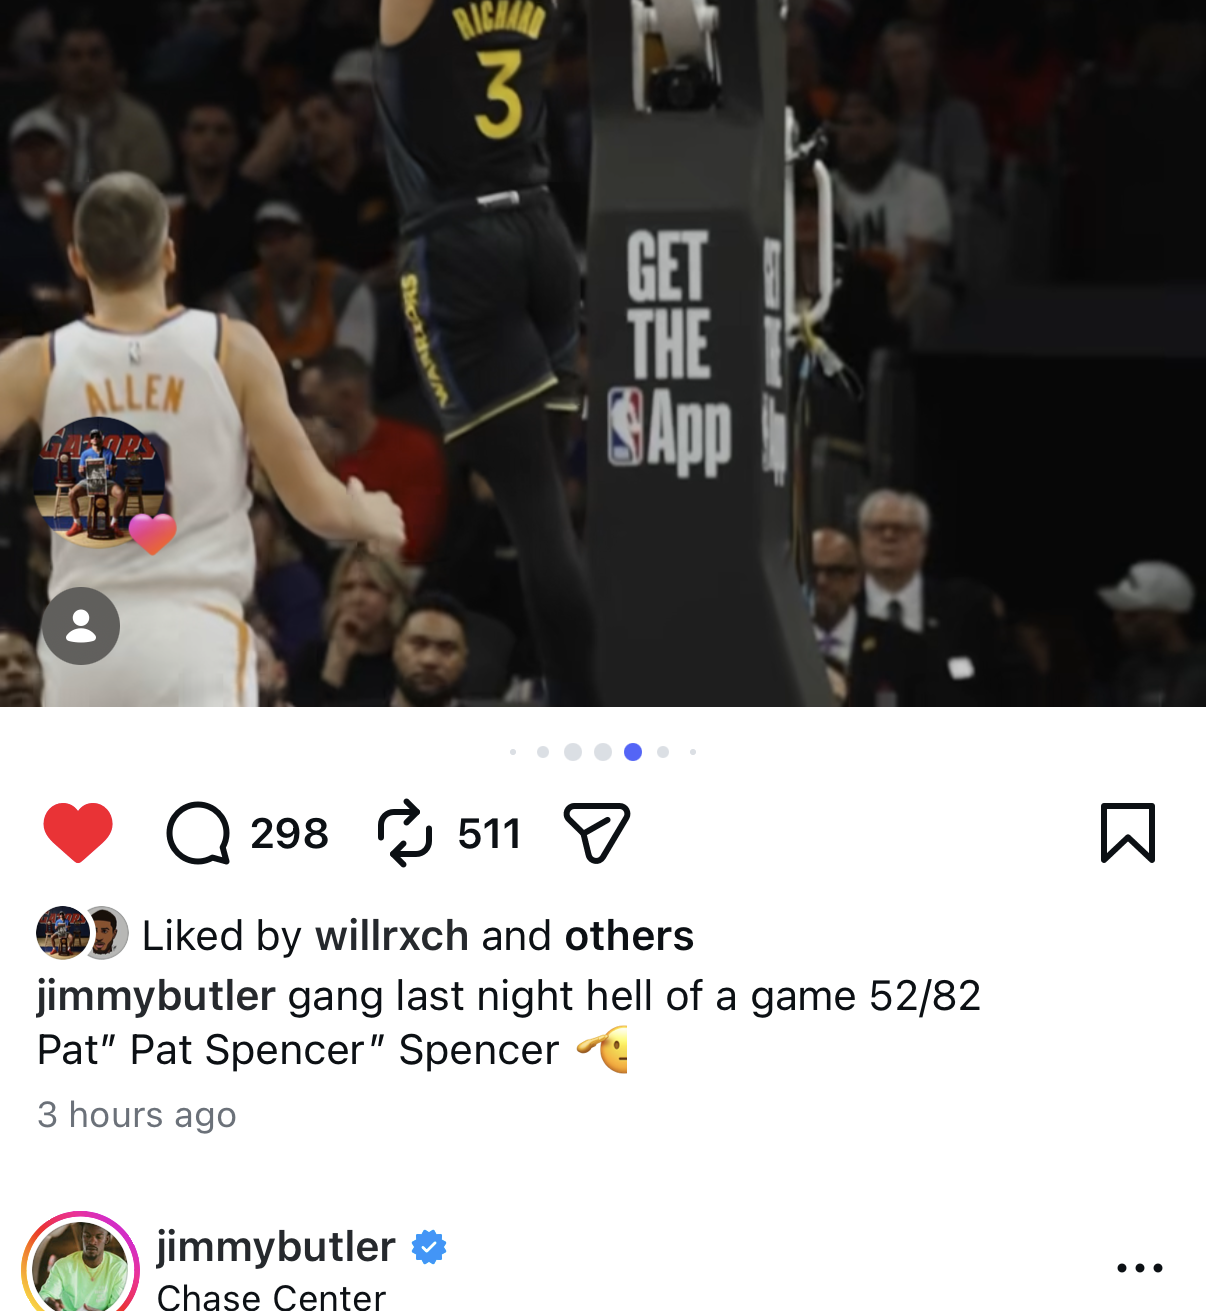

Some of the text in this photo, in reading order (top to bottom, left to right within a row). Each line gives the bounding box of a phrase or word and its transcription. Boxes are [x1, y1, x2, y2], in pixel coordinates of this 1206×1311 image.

[475, 49, 522, 139] 3
[627, 230, 709, 302] GET
[627, 307, 711, 379] THE
[84, 373, 185, 417] ALLEN
[647, 388, 732, 479] App
[252, 816, 328, 850] 298
[459, 817, 519, 850] 511
[145, 918, 694, 959] Liked by willrxch and others
[36, 978, 980, 1019] jimmybutler gang last night hell of a game 52/82
[133, 1034, 191, 1066] Pat
[400, 1033, 559, 1073] Spencer
[39, 1100, 235, 1135] 3 hours ago
[156, 1229, 396, 1270] jimmybutler
[158, 1284, 387, 1311] Chase Center
